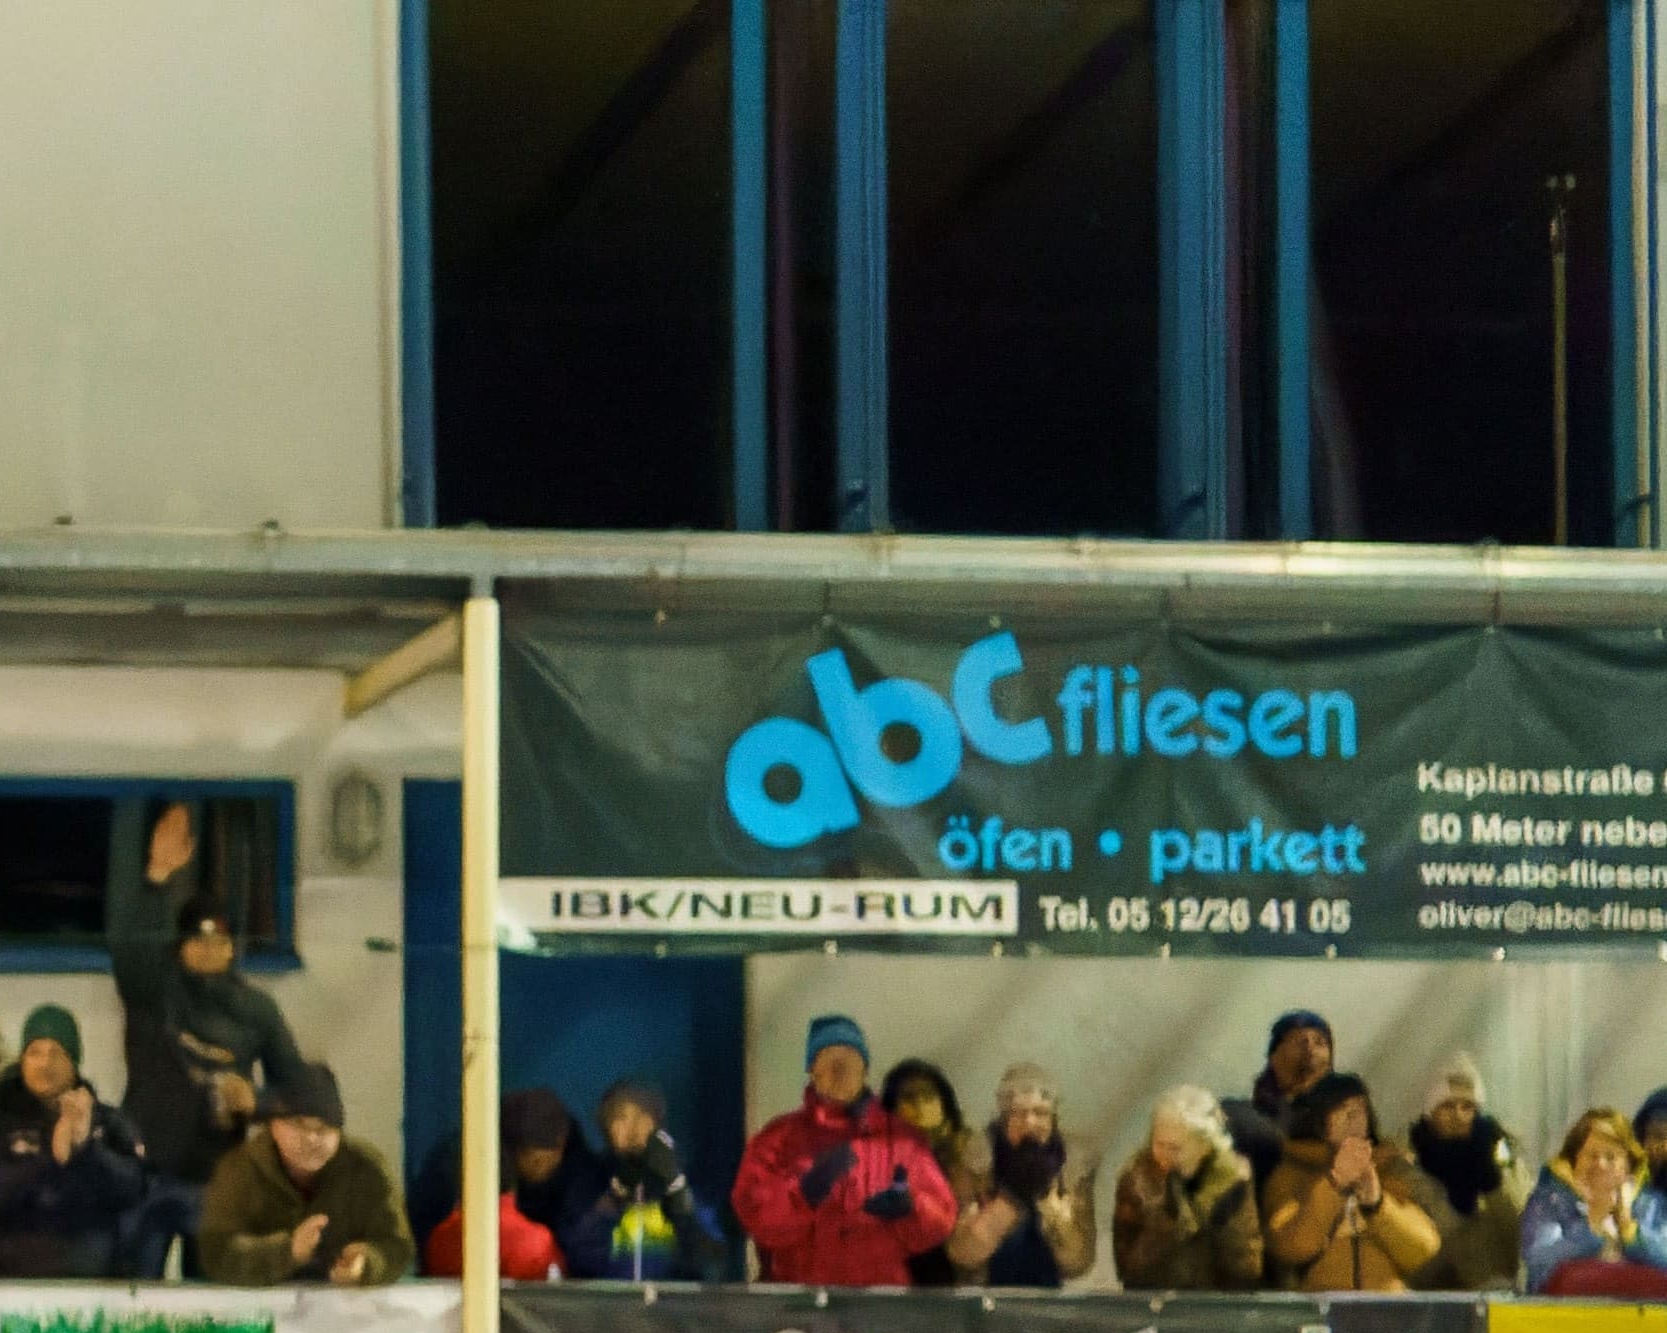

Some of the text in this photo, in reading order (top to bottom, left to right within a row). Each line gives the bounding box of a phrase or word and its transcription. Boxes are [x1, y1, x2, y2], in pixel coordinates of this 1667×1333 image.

[1057, 664, 1359, 759] fliesen
[1471, 811, 1573, 847] Meter
[937, 816, 1367, 885] öfen parkett
[549, 889, 1007, 922] IBK/NEU-RUM
[1038, 894, 1099, 932] Tel.
[1258, 897, 1298, 934] 41
